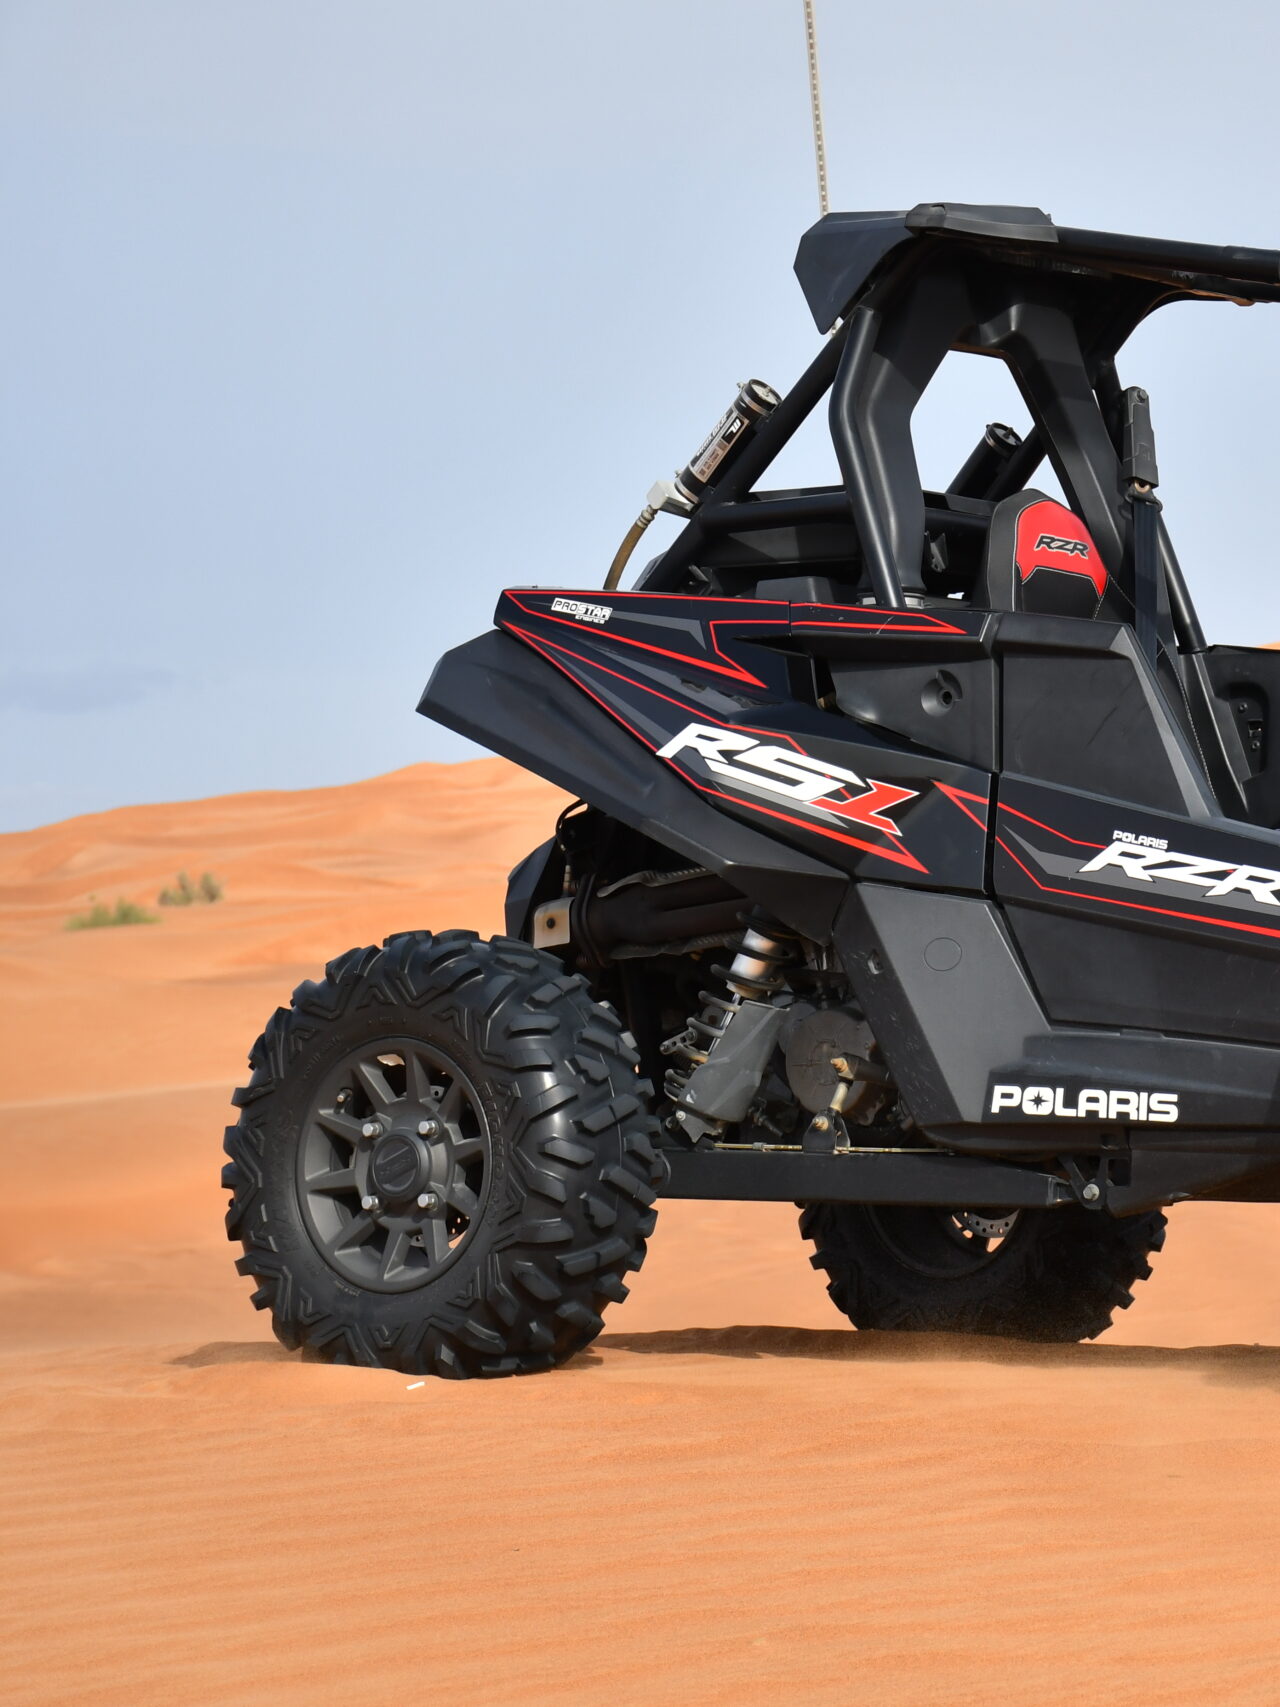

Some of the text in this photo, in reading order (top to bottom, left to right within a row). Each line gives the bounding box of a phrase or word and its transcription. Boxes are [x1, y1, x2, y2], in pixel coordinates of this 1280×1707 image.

[1034, 534, 1089, 559] RZR
[552, 599, 612, 620] PROSTAR
[656, 722, 921, 837] RS1
[1112, 830, 1169, 850] POLARIS
[990, 1085, 1179, 1123] POLARIS
